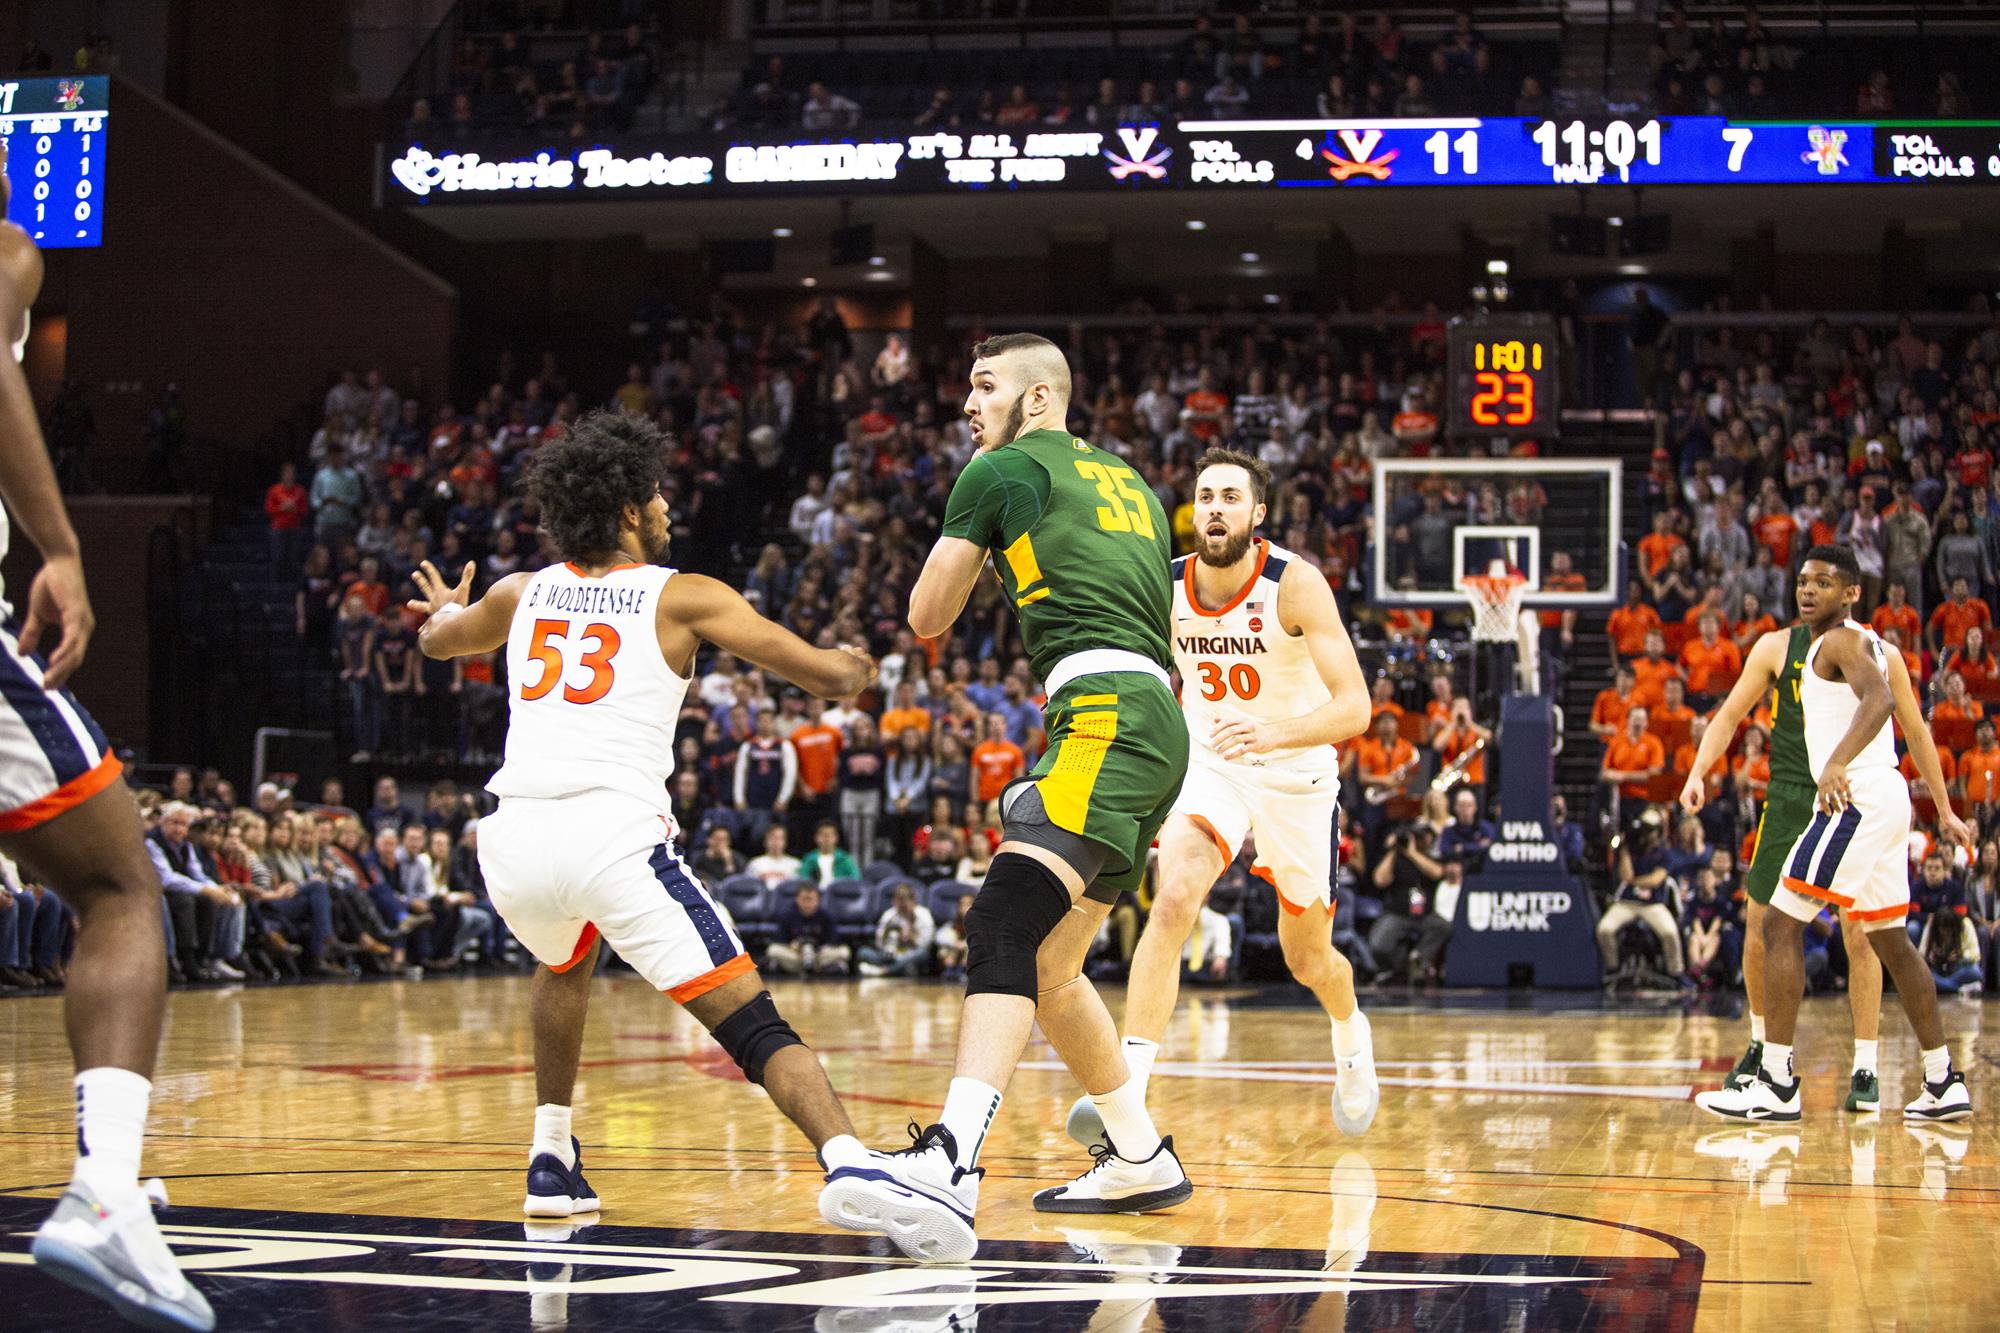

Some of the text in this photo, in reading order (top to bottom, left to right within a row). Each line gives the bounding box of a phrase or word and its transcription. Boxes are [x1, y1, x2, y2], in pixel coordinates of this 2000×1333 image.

[36, 136, 52, 155] 0
[81, 134, 91, 152] 1
[1425, 131, 1478, 174] 11
[1533, 120, 1661, 166] 11:01
[1722, 128, 1753, 171] 7
[1891, 135, 1940, 155] TOL
[35, 157, 90, 178] 0 1
[441, 152, 573, 191] Harris
[726, 143, 904, 183] GAMEDAY
[1191, 160, 1275, 183] FOULS
[1894, 155, 1975, 177] FOULS
[33, 179, 92, 200] 0 0
[36, 201, 91, 222] 1 0
[1472, 372, 1534, 426] 23
[1074, 460, 1155, 540] 35
[546, 584, 646, 614] WOLDETENSAE
[1177, 637, 1268, 655] VIRGINIA
[521, 619, 621, 705] 53
[1197, 662, 1261, 702] 30
[1502, 821, 1544, 840] UVA
[1489, 843, 1558, 862] ORTHO
[1491, 892, 1571, 914] UNITED
[1491, 911, 1551, 931] BANK
